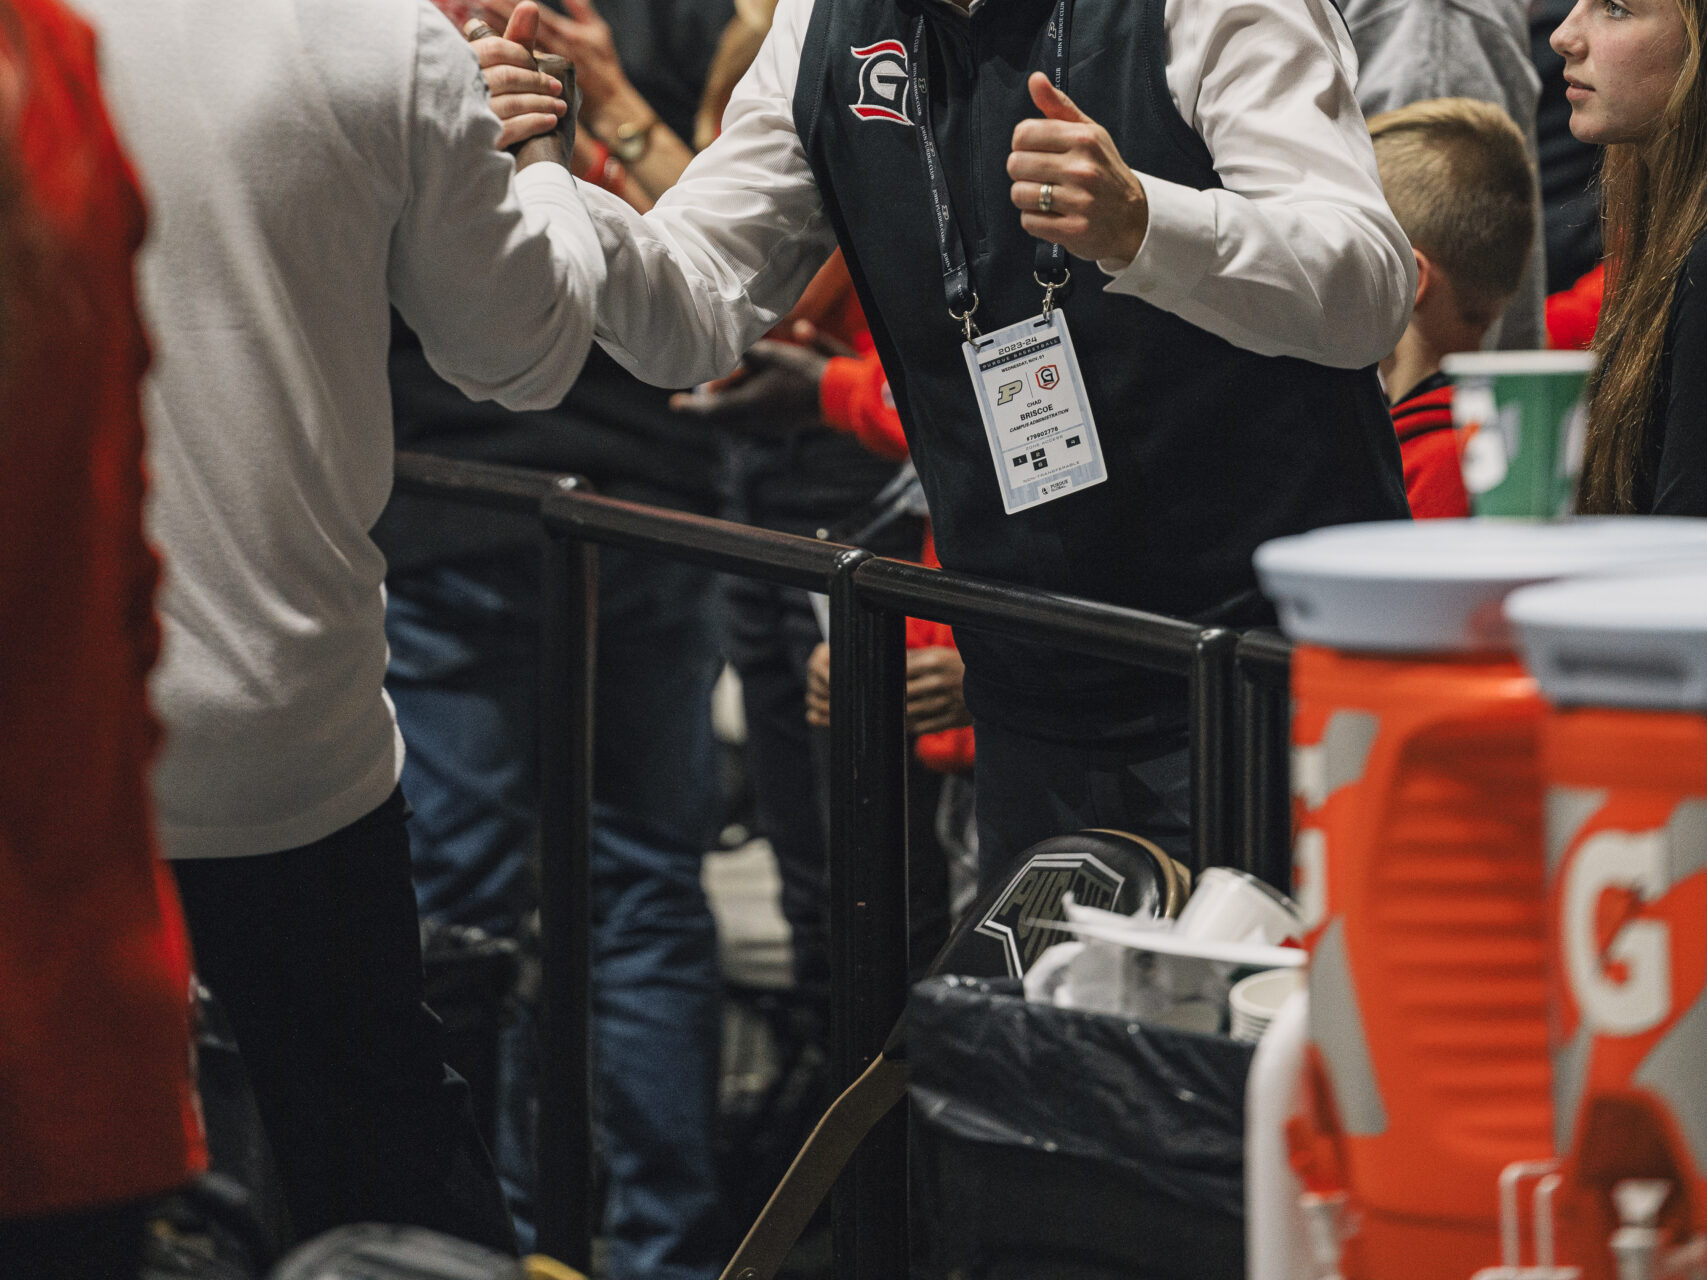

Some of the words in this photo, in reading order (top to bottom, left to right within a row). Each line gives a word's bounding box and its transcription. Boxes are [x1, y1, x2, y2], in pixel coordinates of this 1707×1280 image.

[1048, 22, 1057, 39] P
[982, 356, 1010, 369] PURDUE
[1013, 339, 1058, 358] BASKETBALL
[998, 336, 1037, 355] 2023-24
[997, 380, 1023, 406] P
[1027, 399, 1042, 407] CHAD
[1010, 421, 1030, 433] CAMPUS
[1030, 408, 1069, 426] ADMINISTRATION
[1020, 404, 1053, 421] BRISCOE
[1561, 827, 1672, 1039] G
